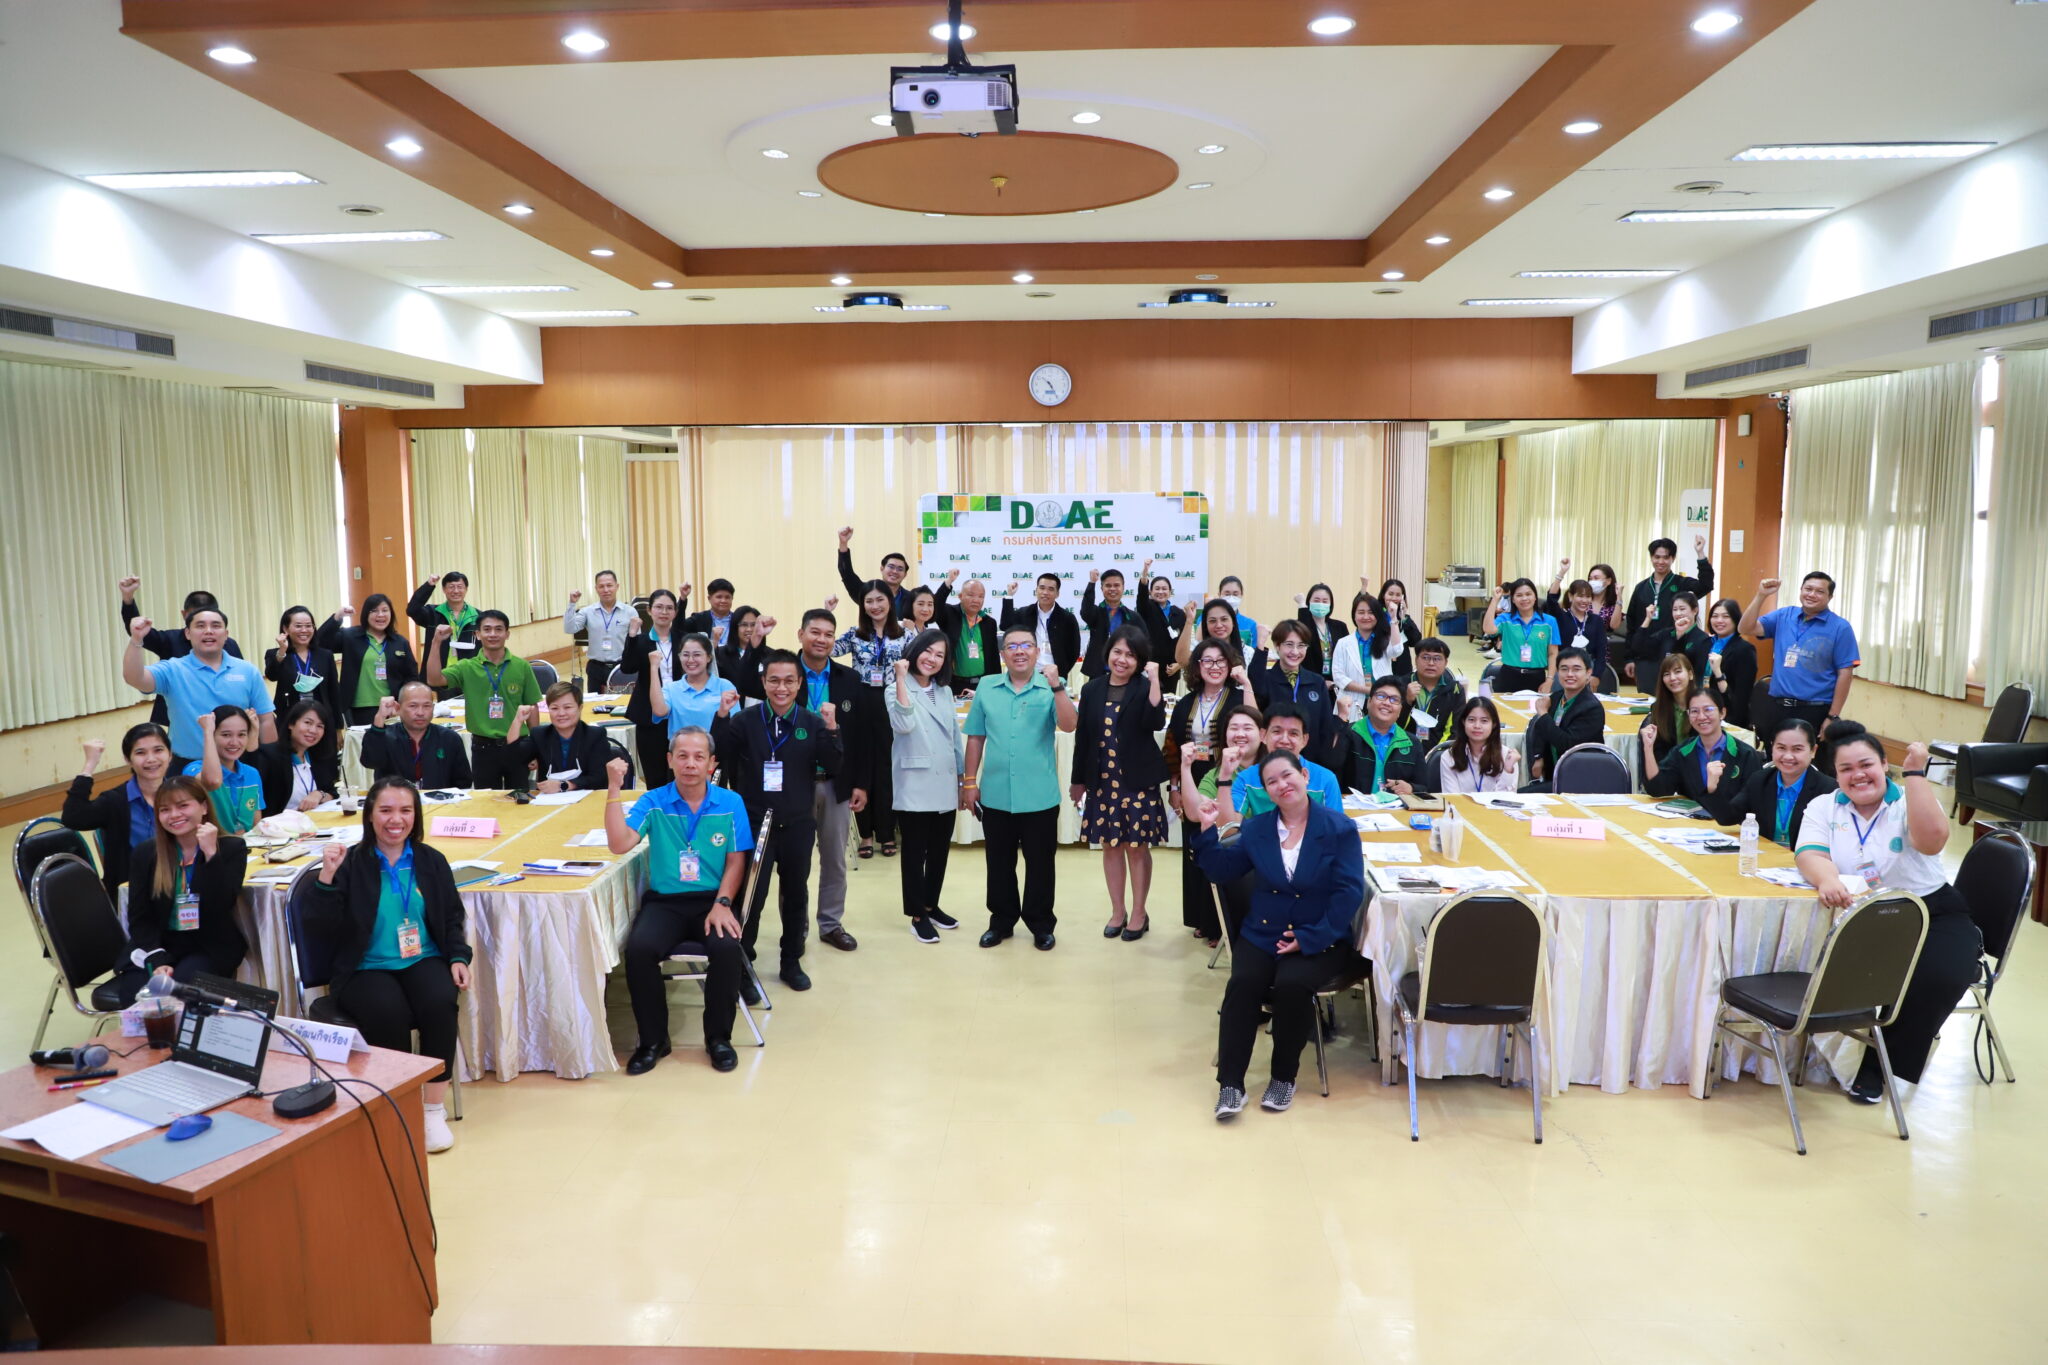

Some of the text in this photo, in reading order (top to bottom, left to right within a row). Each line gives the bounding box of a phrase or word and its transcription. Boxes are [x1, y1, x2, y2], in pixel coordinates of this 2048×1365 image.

[1003, 533, 1122, 545] กรมส่งเสริมการเกษตร
[443, 821, 476, 836] กลุ่มที่ 2
[1547, 821, 1573, 836] กลุ่มที่
